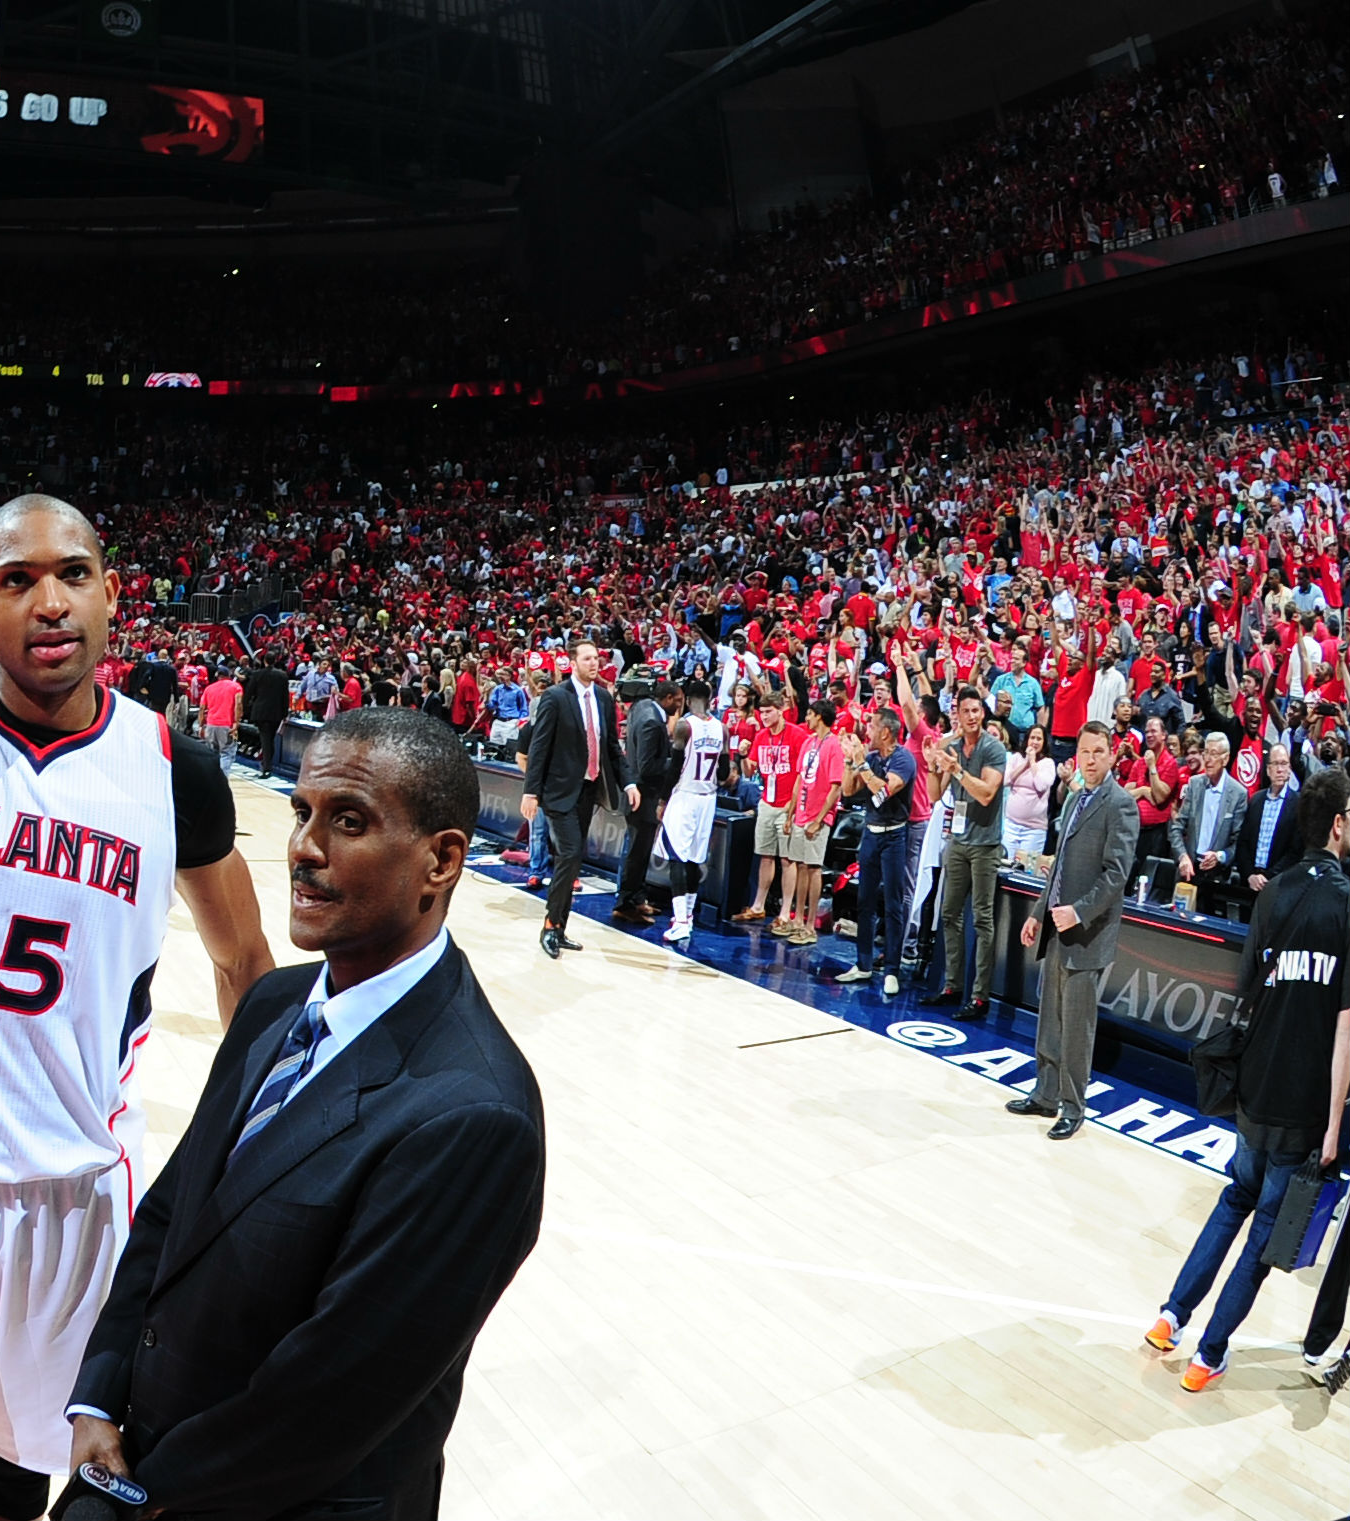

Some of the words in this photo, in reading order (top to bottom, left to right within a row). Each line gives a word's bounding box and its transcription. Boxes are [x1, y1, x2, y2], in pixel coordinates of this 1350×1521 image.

[21, 93, 58, 122] GO
[69, 96, 108, 126] UP
[52, 365, 60, 377] 4
[86, 373, 104, 386] TOL
[694, 751, 719, 781] 17
[1312, 951, 1337, 985] TV
[119, 1483, 143, 1501] NBA
